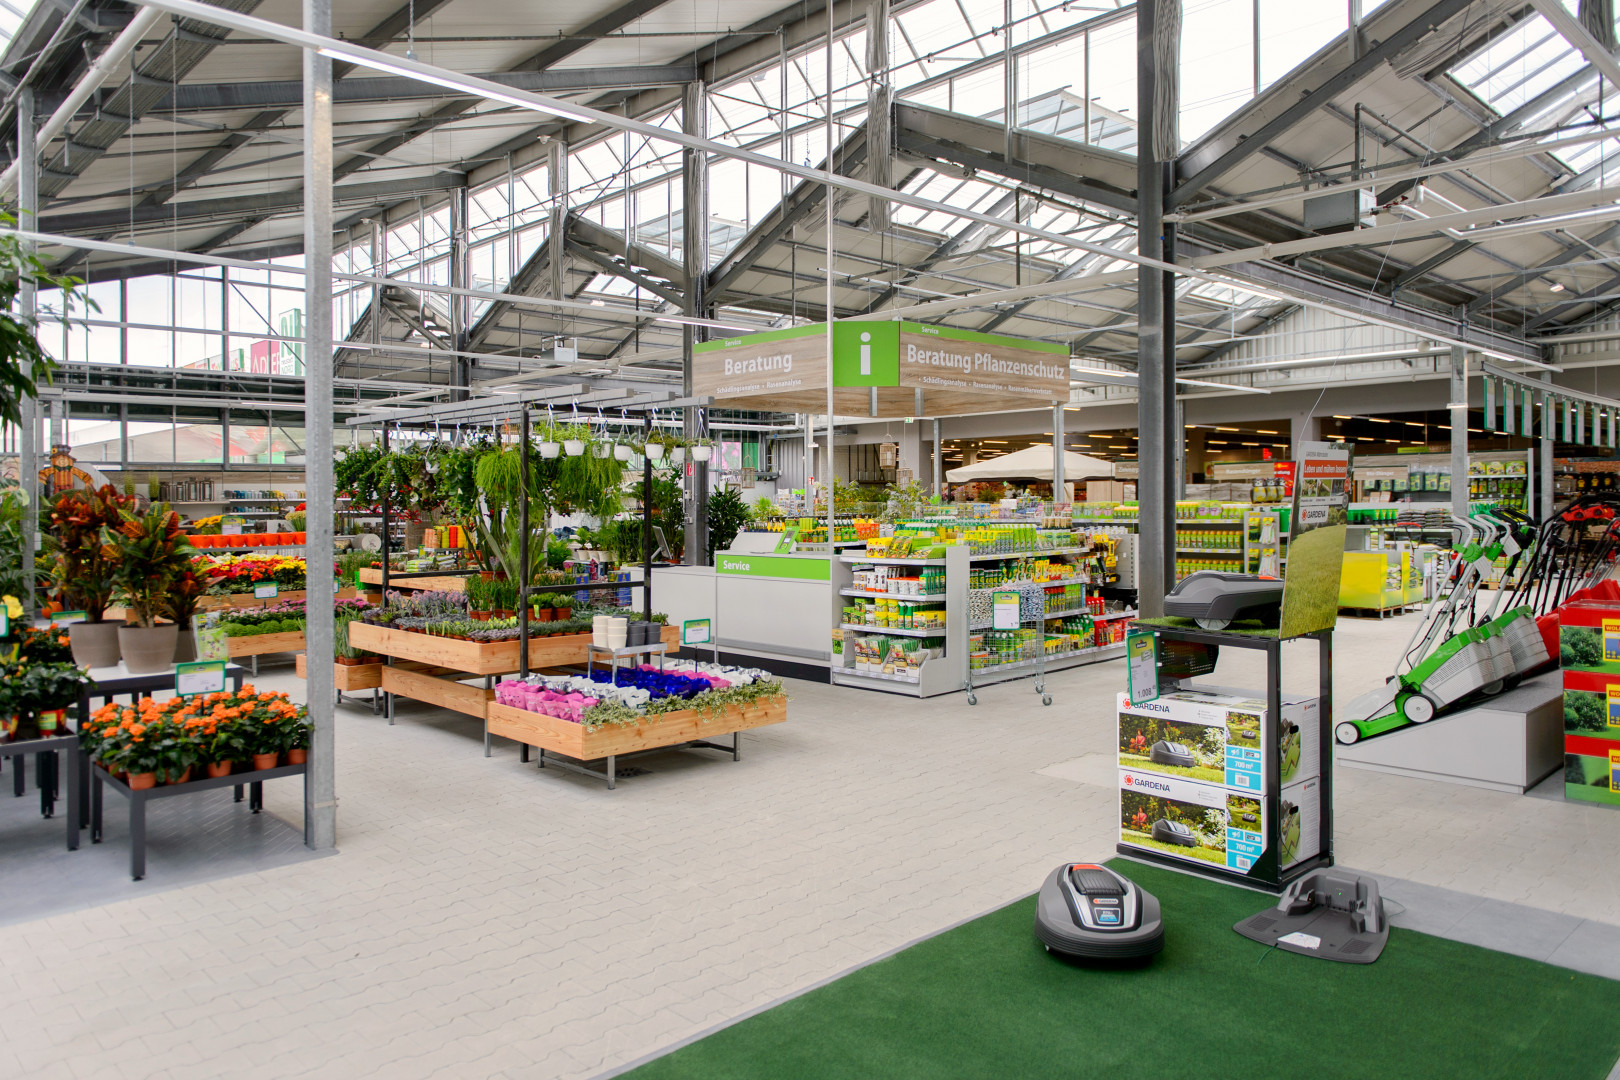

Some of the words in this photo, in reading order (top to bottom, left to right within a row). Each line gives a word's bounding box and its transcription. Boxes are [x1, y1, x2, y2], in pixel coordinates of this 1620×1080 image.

[921, 326, 939, 335] Service
[725, 339, 742, 347] Service
[724, 353, 793, 376] Beratung
[907, 343, 971, 374] Beratung
[974, 352, 1065, 380] Pflanzenschutz
[716, 383, 760, 394] Schädlingsanalyse
[923, 376, 967, 388] Schädlingsanalyse
[972, 381, 1003, 391] Rasenanalyse
[1304, 464, 1316, 473] Leben
[1316, 464, 1324, 473] und
[1307, 510, 1326, 519] GARDENA
[723, 559, 750, 571] Service
[1133, 702, 1170, 713] GARDENA
[1235, 761, 1246, 769] 700
[1134, 778, 1171, 792] GARDENA
[1236, 843, 1247, 852] 700
